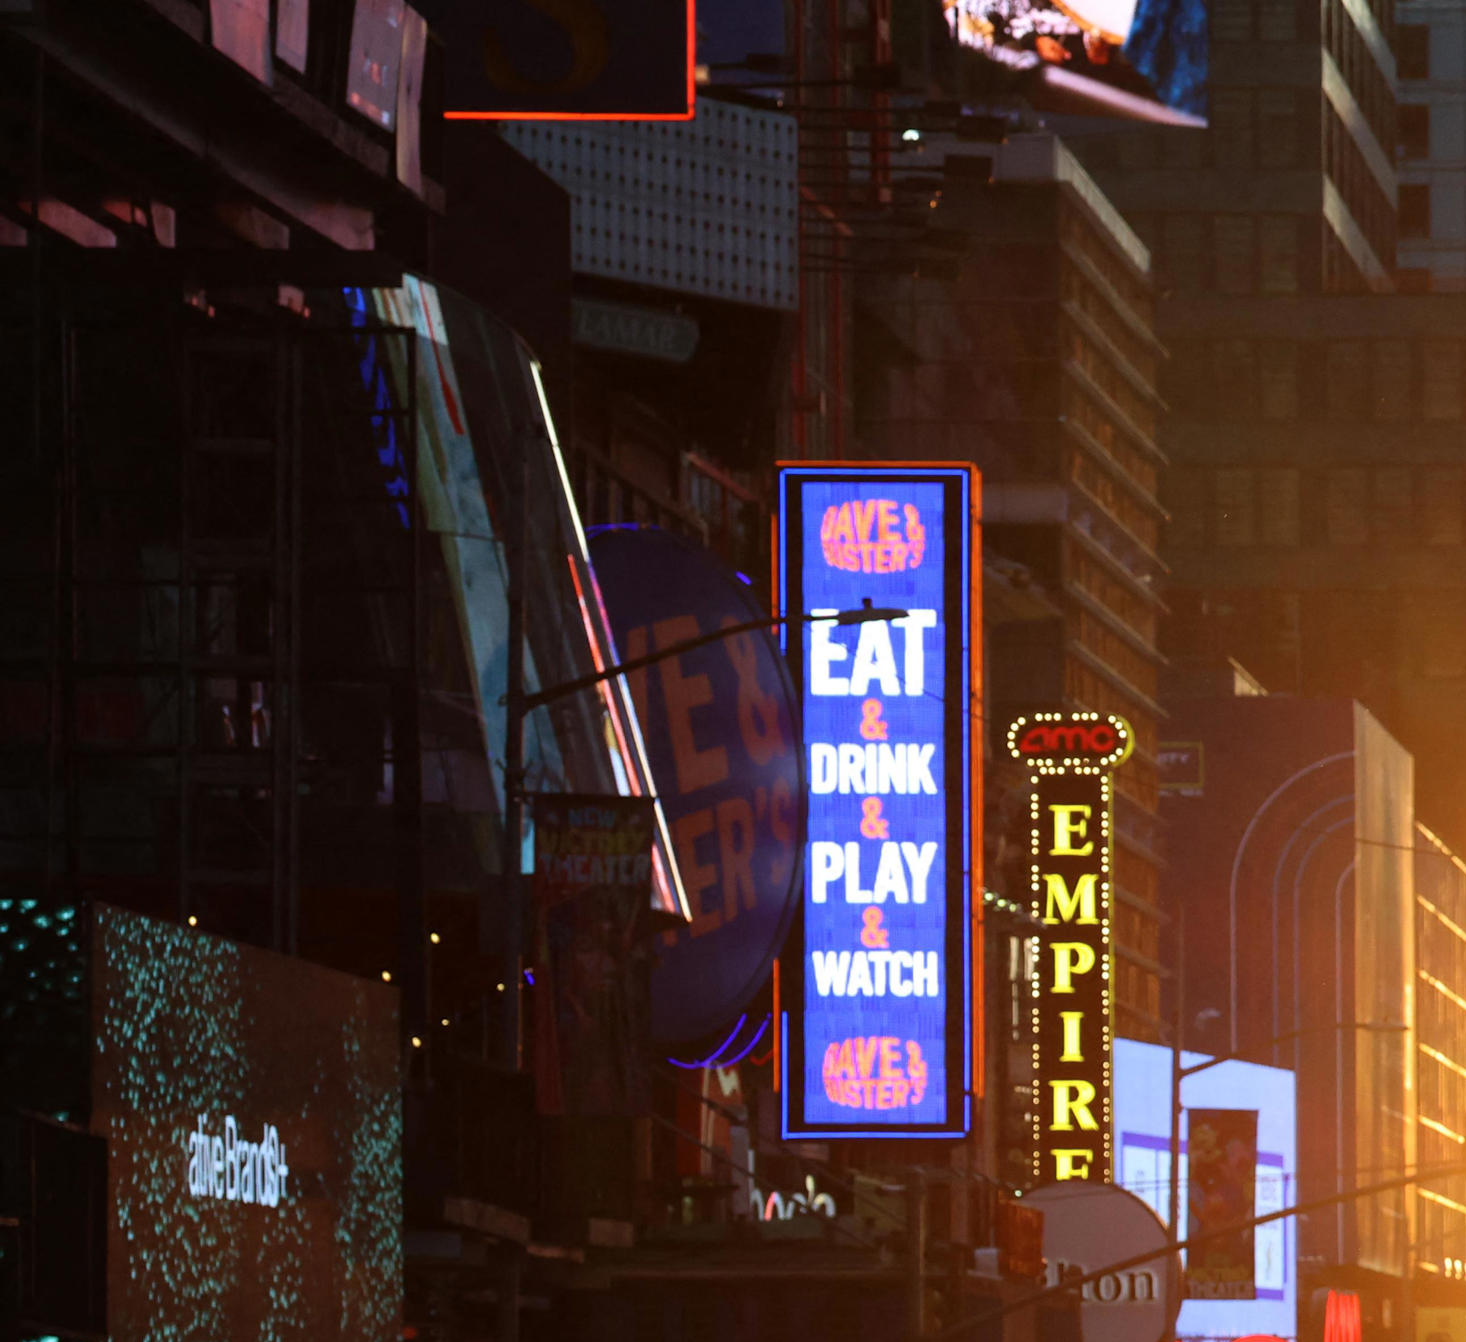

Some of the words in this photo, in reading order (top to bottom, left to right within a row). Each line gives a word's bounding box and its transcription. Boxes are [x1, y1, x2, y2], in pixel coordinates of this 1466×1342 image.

[810, 608, 937, 696] EAT
[859, 697, 890, 740] &
[1020, 726, 1115, 754] amc
[810, 742, 938, 795] DRINK
[859, 796, 890, 839] &
[810, 841, 938, 905] PLAY
[859, 905, 890, 949] &
[811, 950, 939, 997] WATCH
